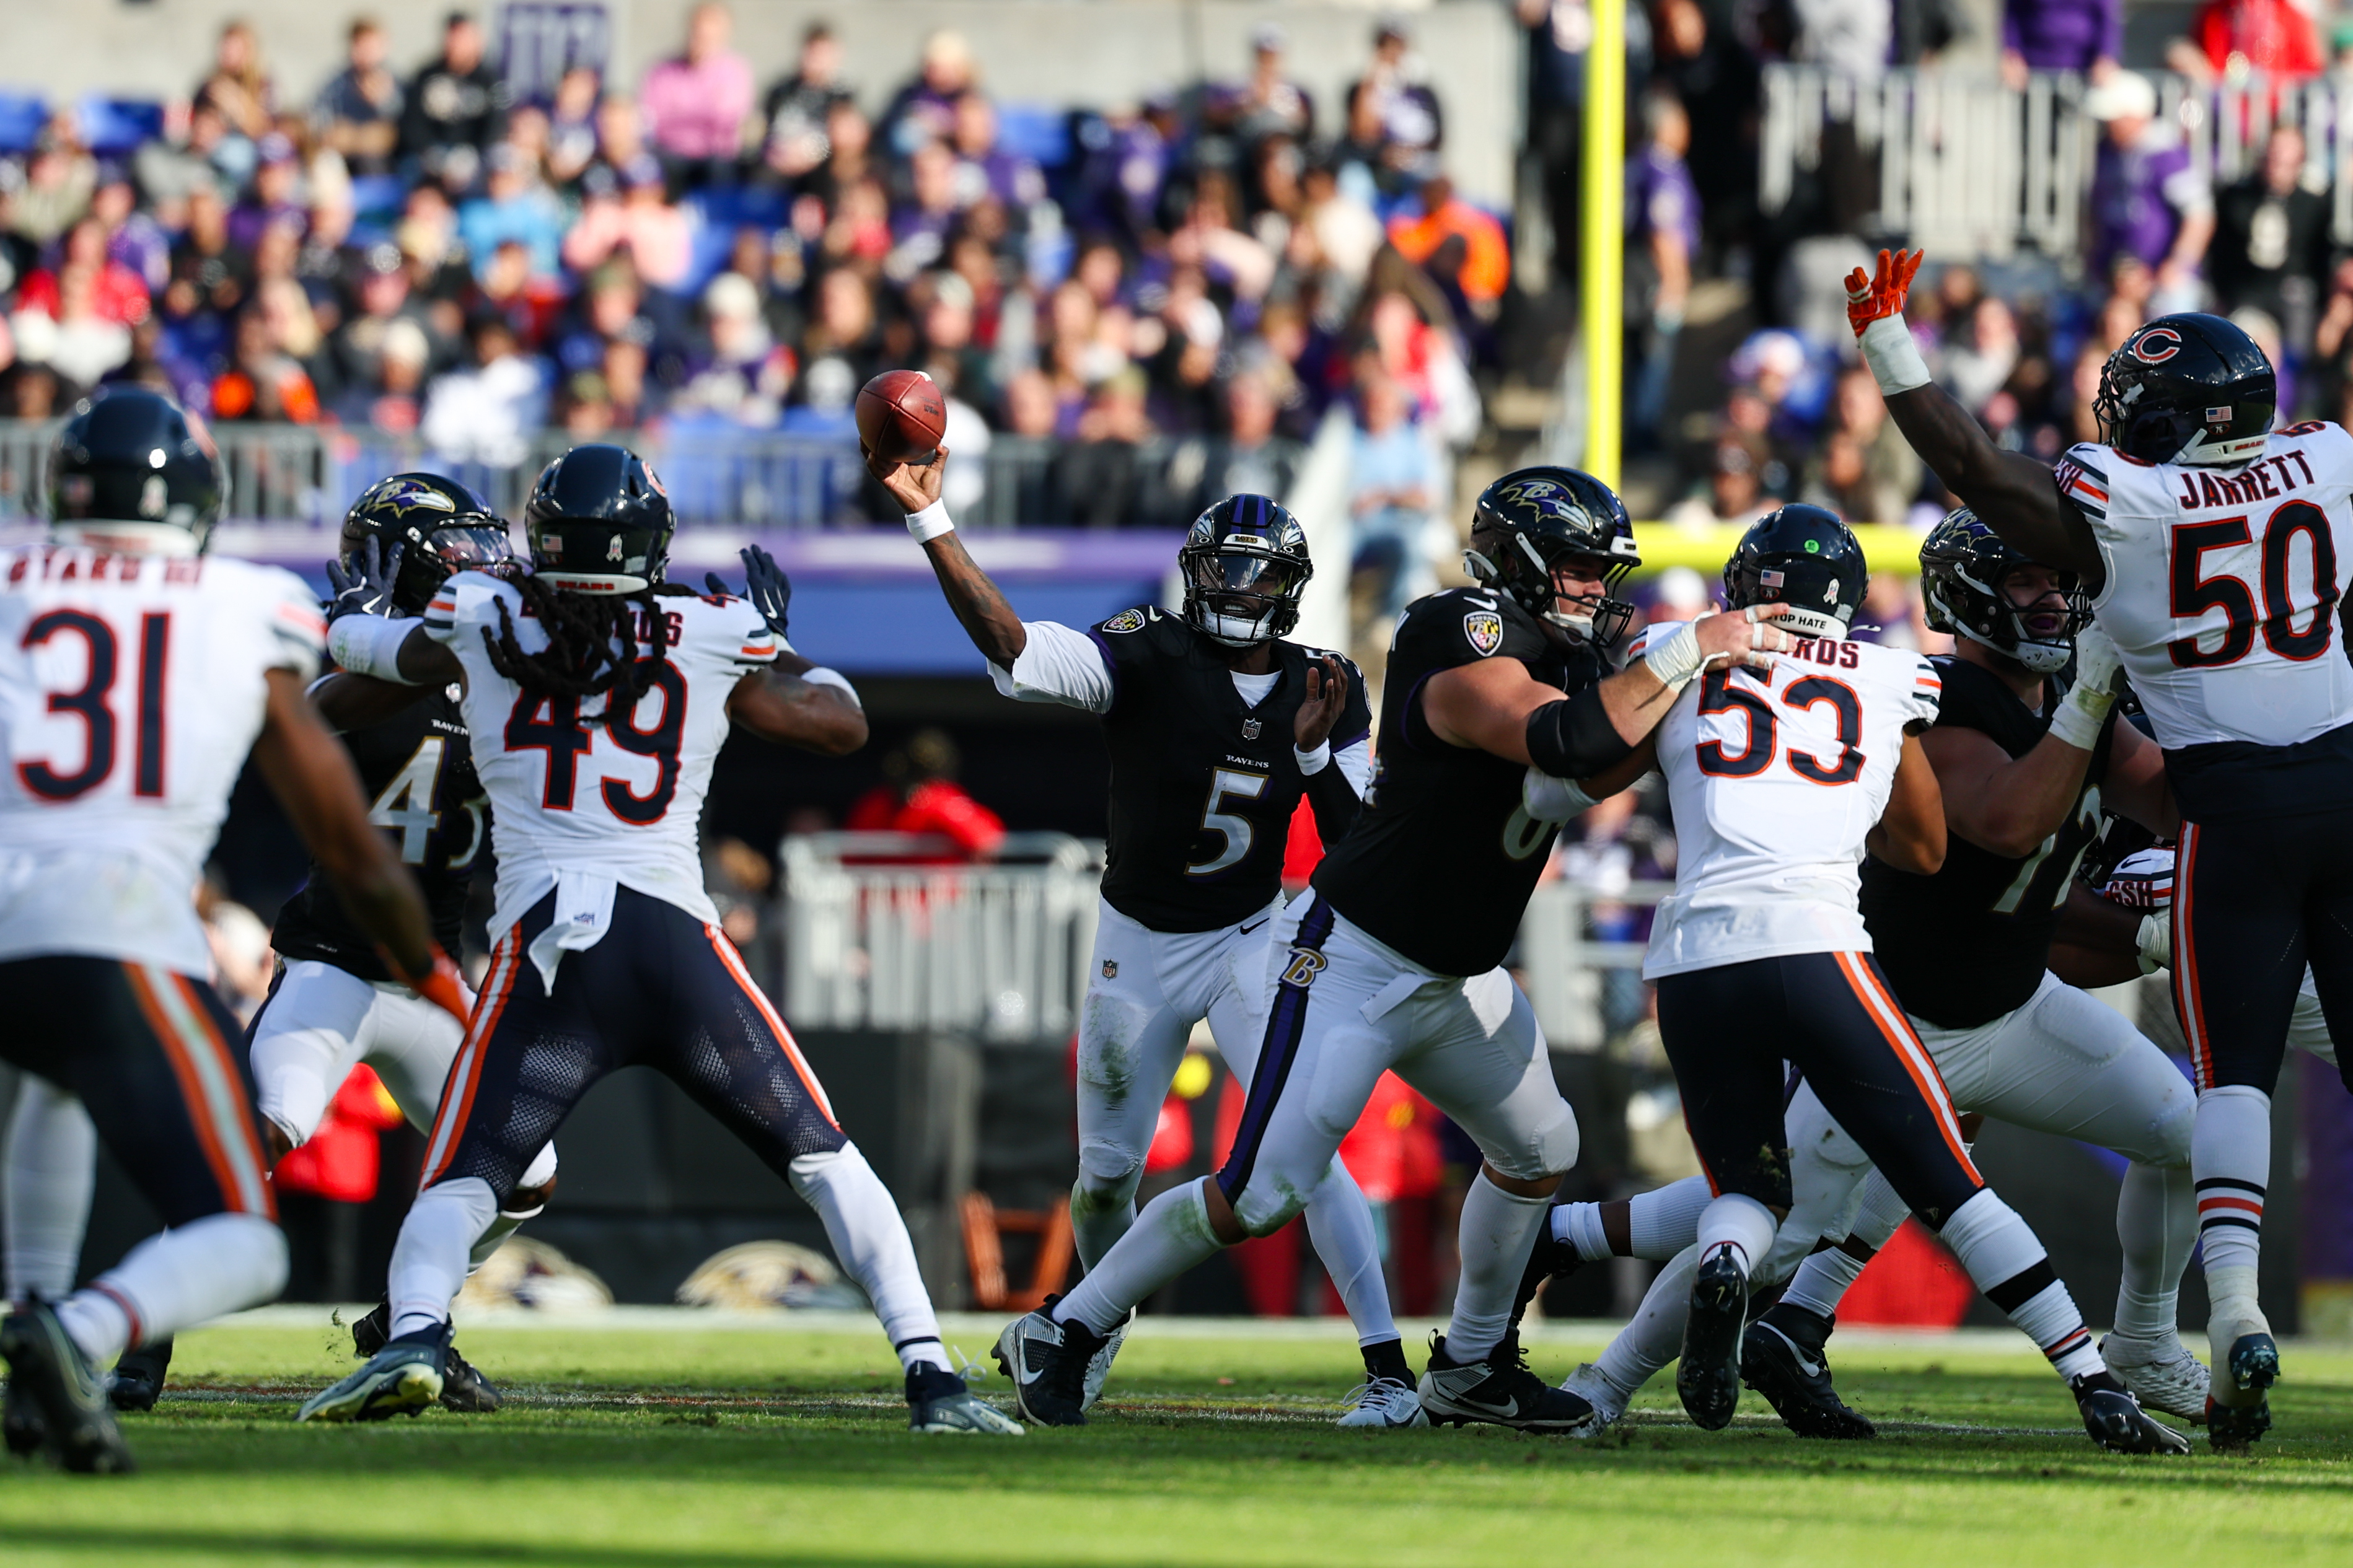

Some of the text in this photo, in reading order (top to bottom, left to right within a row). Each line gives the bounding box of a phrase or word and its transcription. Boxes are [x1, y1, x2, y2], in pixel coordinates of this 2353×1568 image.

[2132, 327, 2182, 364] C
[2179, 449, 2315, 510] JARRETT
[2167, 499, 2341, 668] 50
[1798, 615, 1827, 629] HATE
[16, 606, 171, 802] 31
[431, 719, 469, 736] RAVEN
[1695, 663, 1867, 787] 53
[504, 655, 688, 826] 49
[1226, 754, 1269, 768] RAVENS
[1183, 766, 1270, 876] 5
[1103, 966, 1116, 977] NFL
[1279, 934, 1328, 988] B
